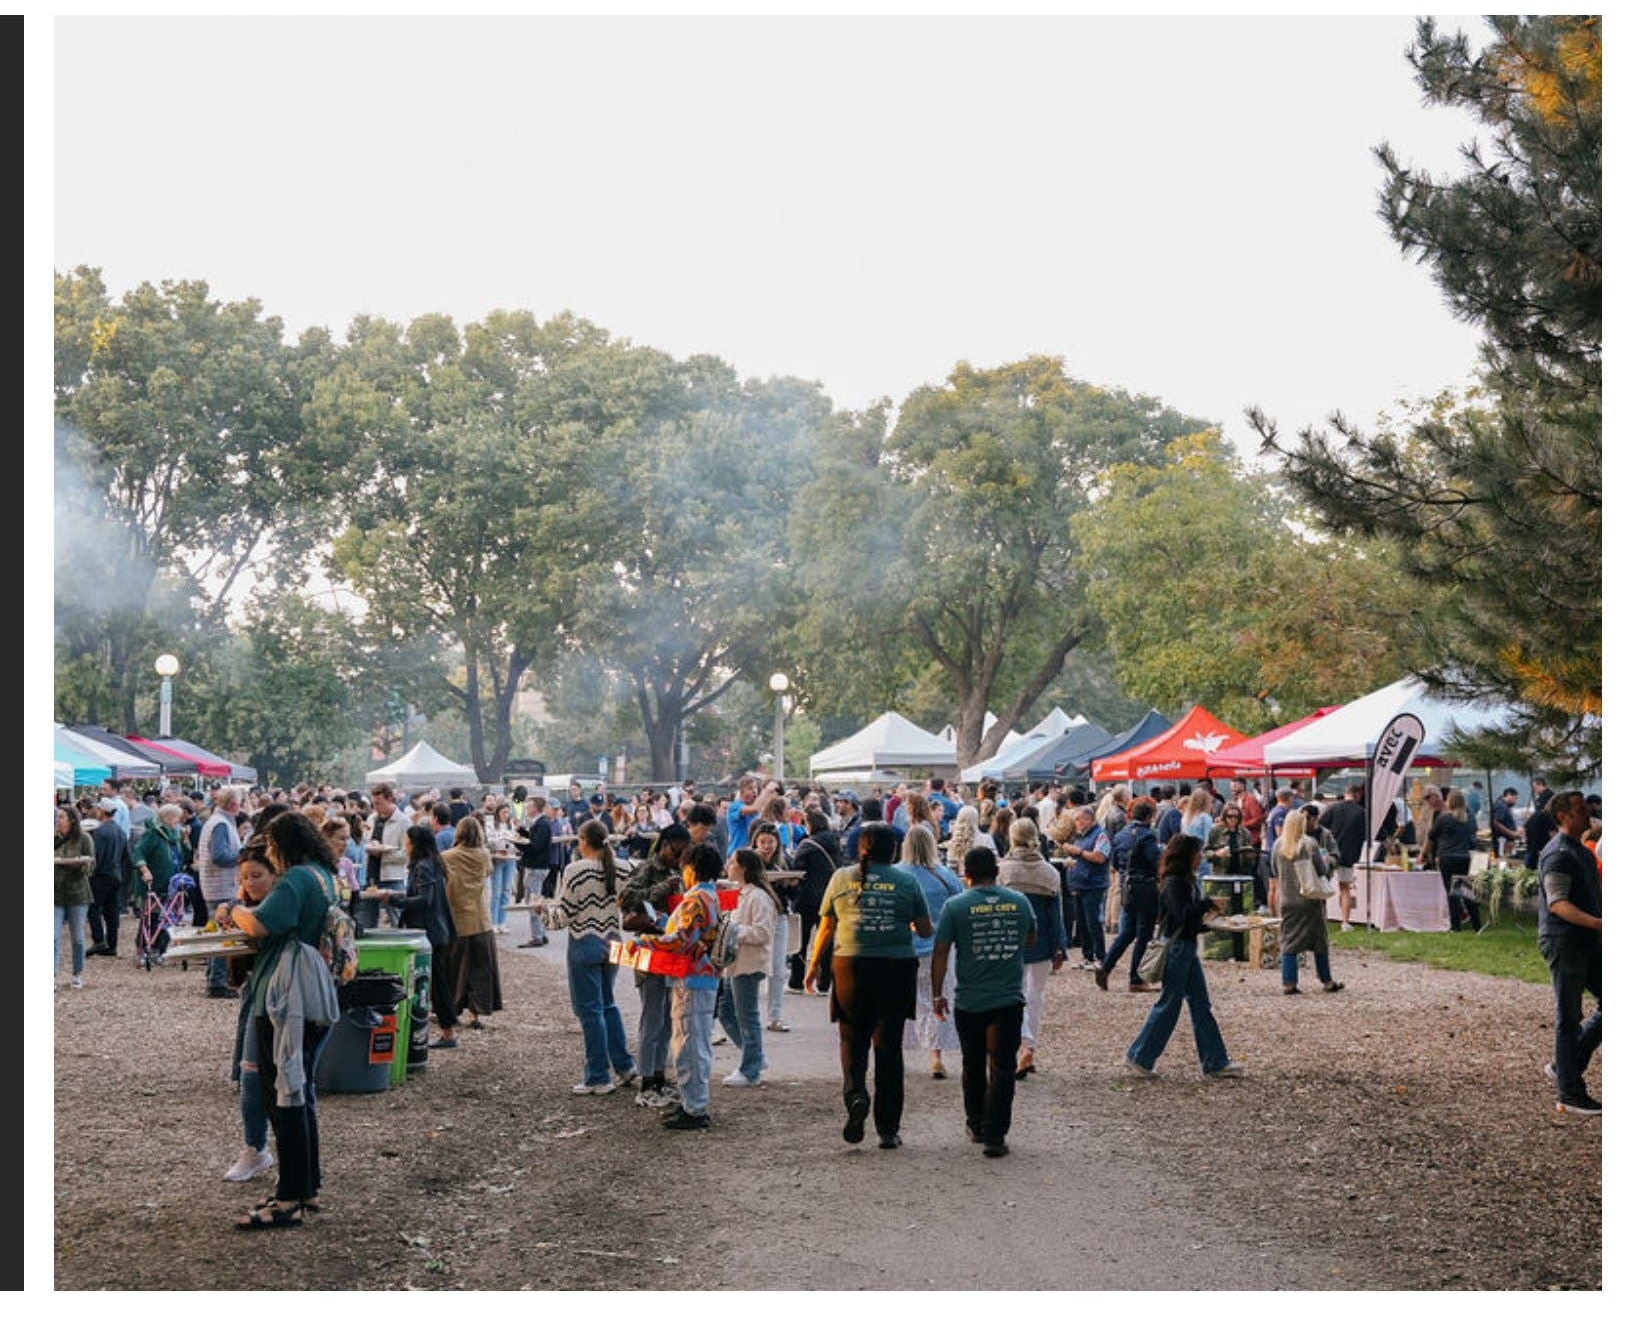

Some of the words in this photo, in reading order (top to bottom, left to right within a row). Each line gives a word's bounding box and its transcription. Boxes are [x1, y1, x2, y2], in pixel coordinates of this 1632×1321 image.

[1377, 727, 1403, 768] avec
[872, 882, 896, 891] CREW
[970, 904, 993, 915] EVENT
[995, 902, 1017, 912] CREW
